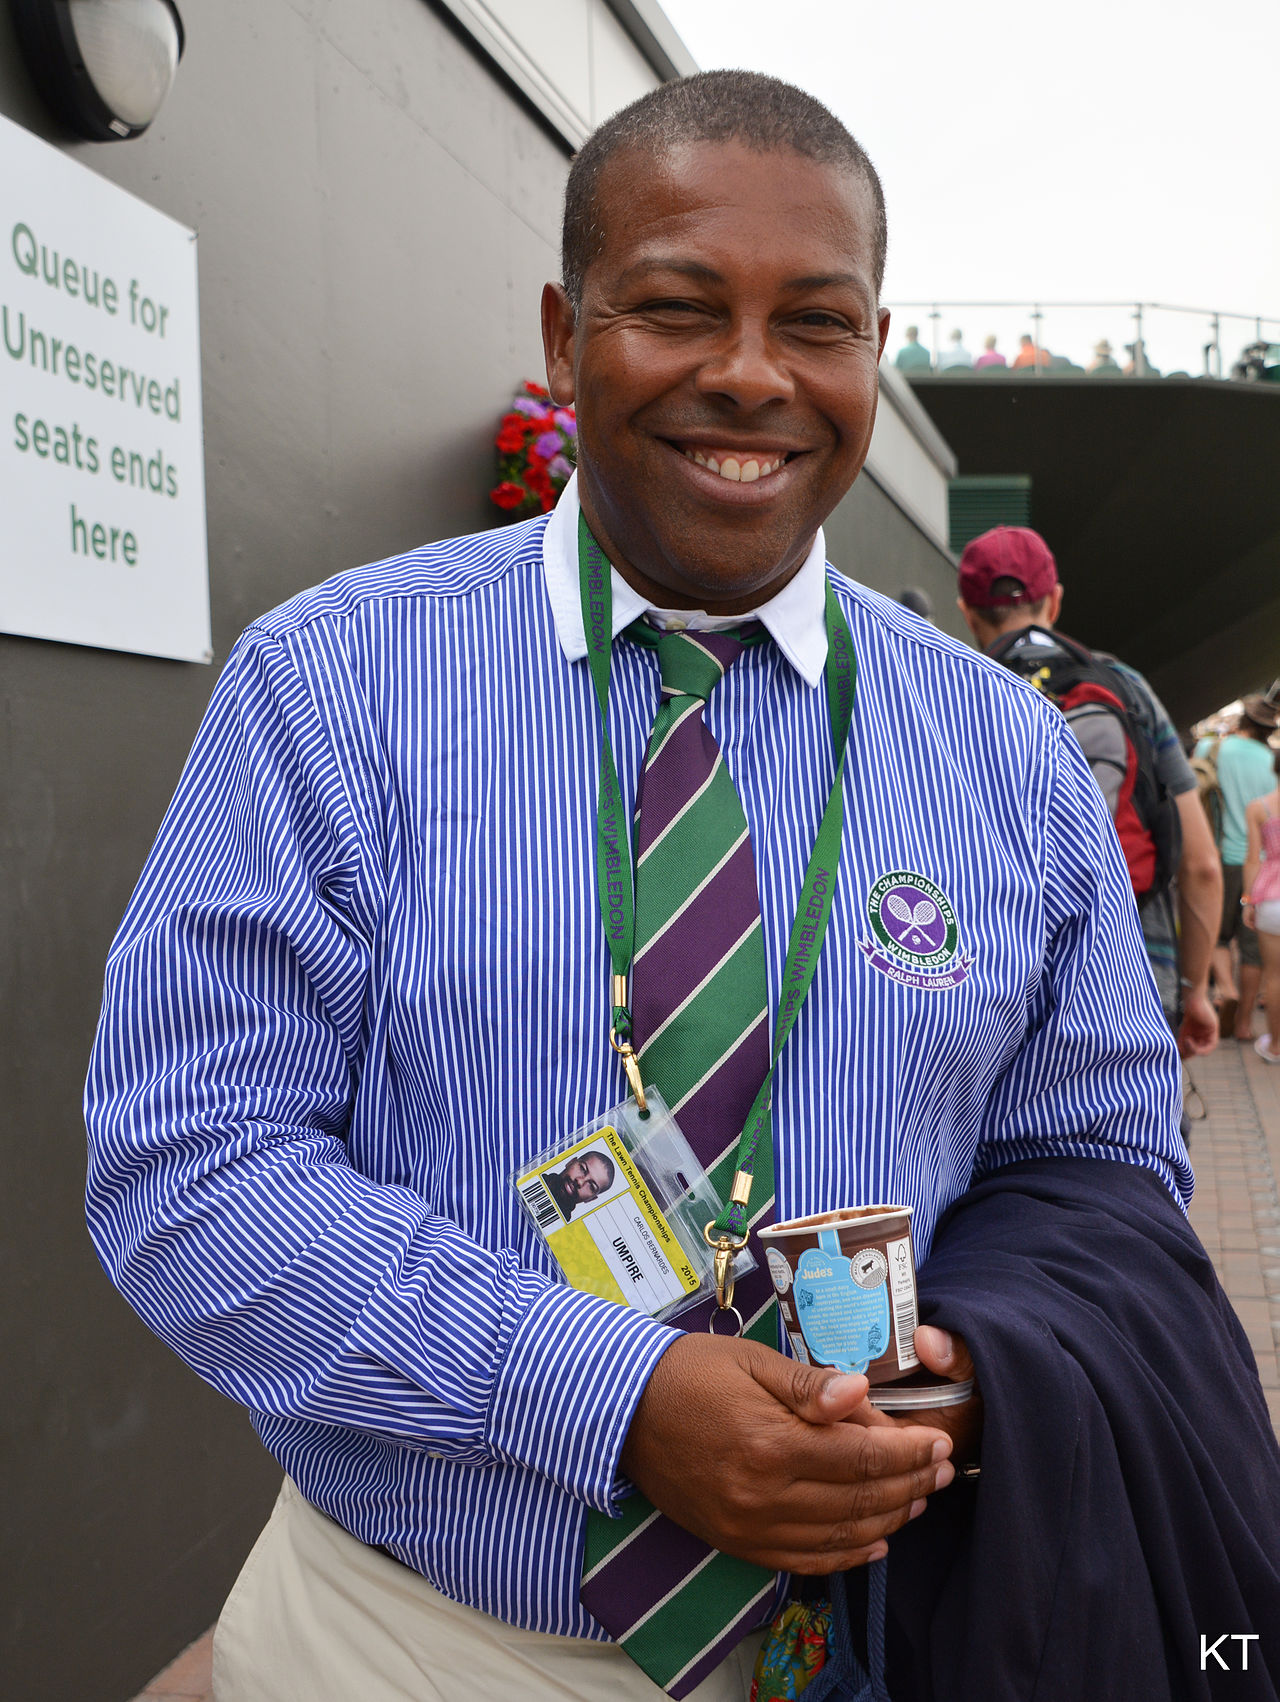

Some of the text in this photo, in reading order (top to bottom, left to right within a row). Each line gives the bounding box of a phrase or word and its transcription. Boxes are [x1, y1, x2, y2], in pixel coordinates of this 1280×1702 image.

[11, 222, 169, 339] Queue for
[2, 304, 181, 423] Unreserved
[15, 412, 178, 499] seats ends
[71, 503, 137, 567] here
[586, 545, 606, 654] WIMBLEDON
[603, 812, 625, 940] WIMBLEDON
[869, 875, 955, 925] THE CHAMPIONSHIPS
[790, 867, 831, 983] WIMBLEDON
[887, 940, 951, 966] WIMBLEDON
[887, 966, 956, 987] RALPH LAUREN
[606, 1132, 697, 1286] The Lawn Tennis Championships 2015
[633, 1216, 669, 1275] CARLOS BERNARDES
[612, 1236, 644, 1284] UMPIRE
